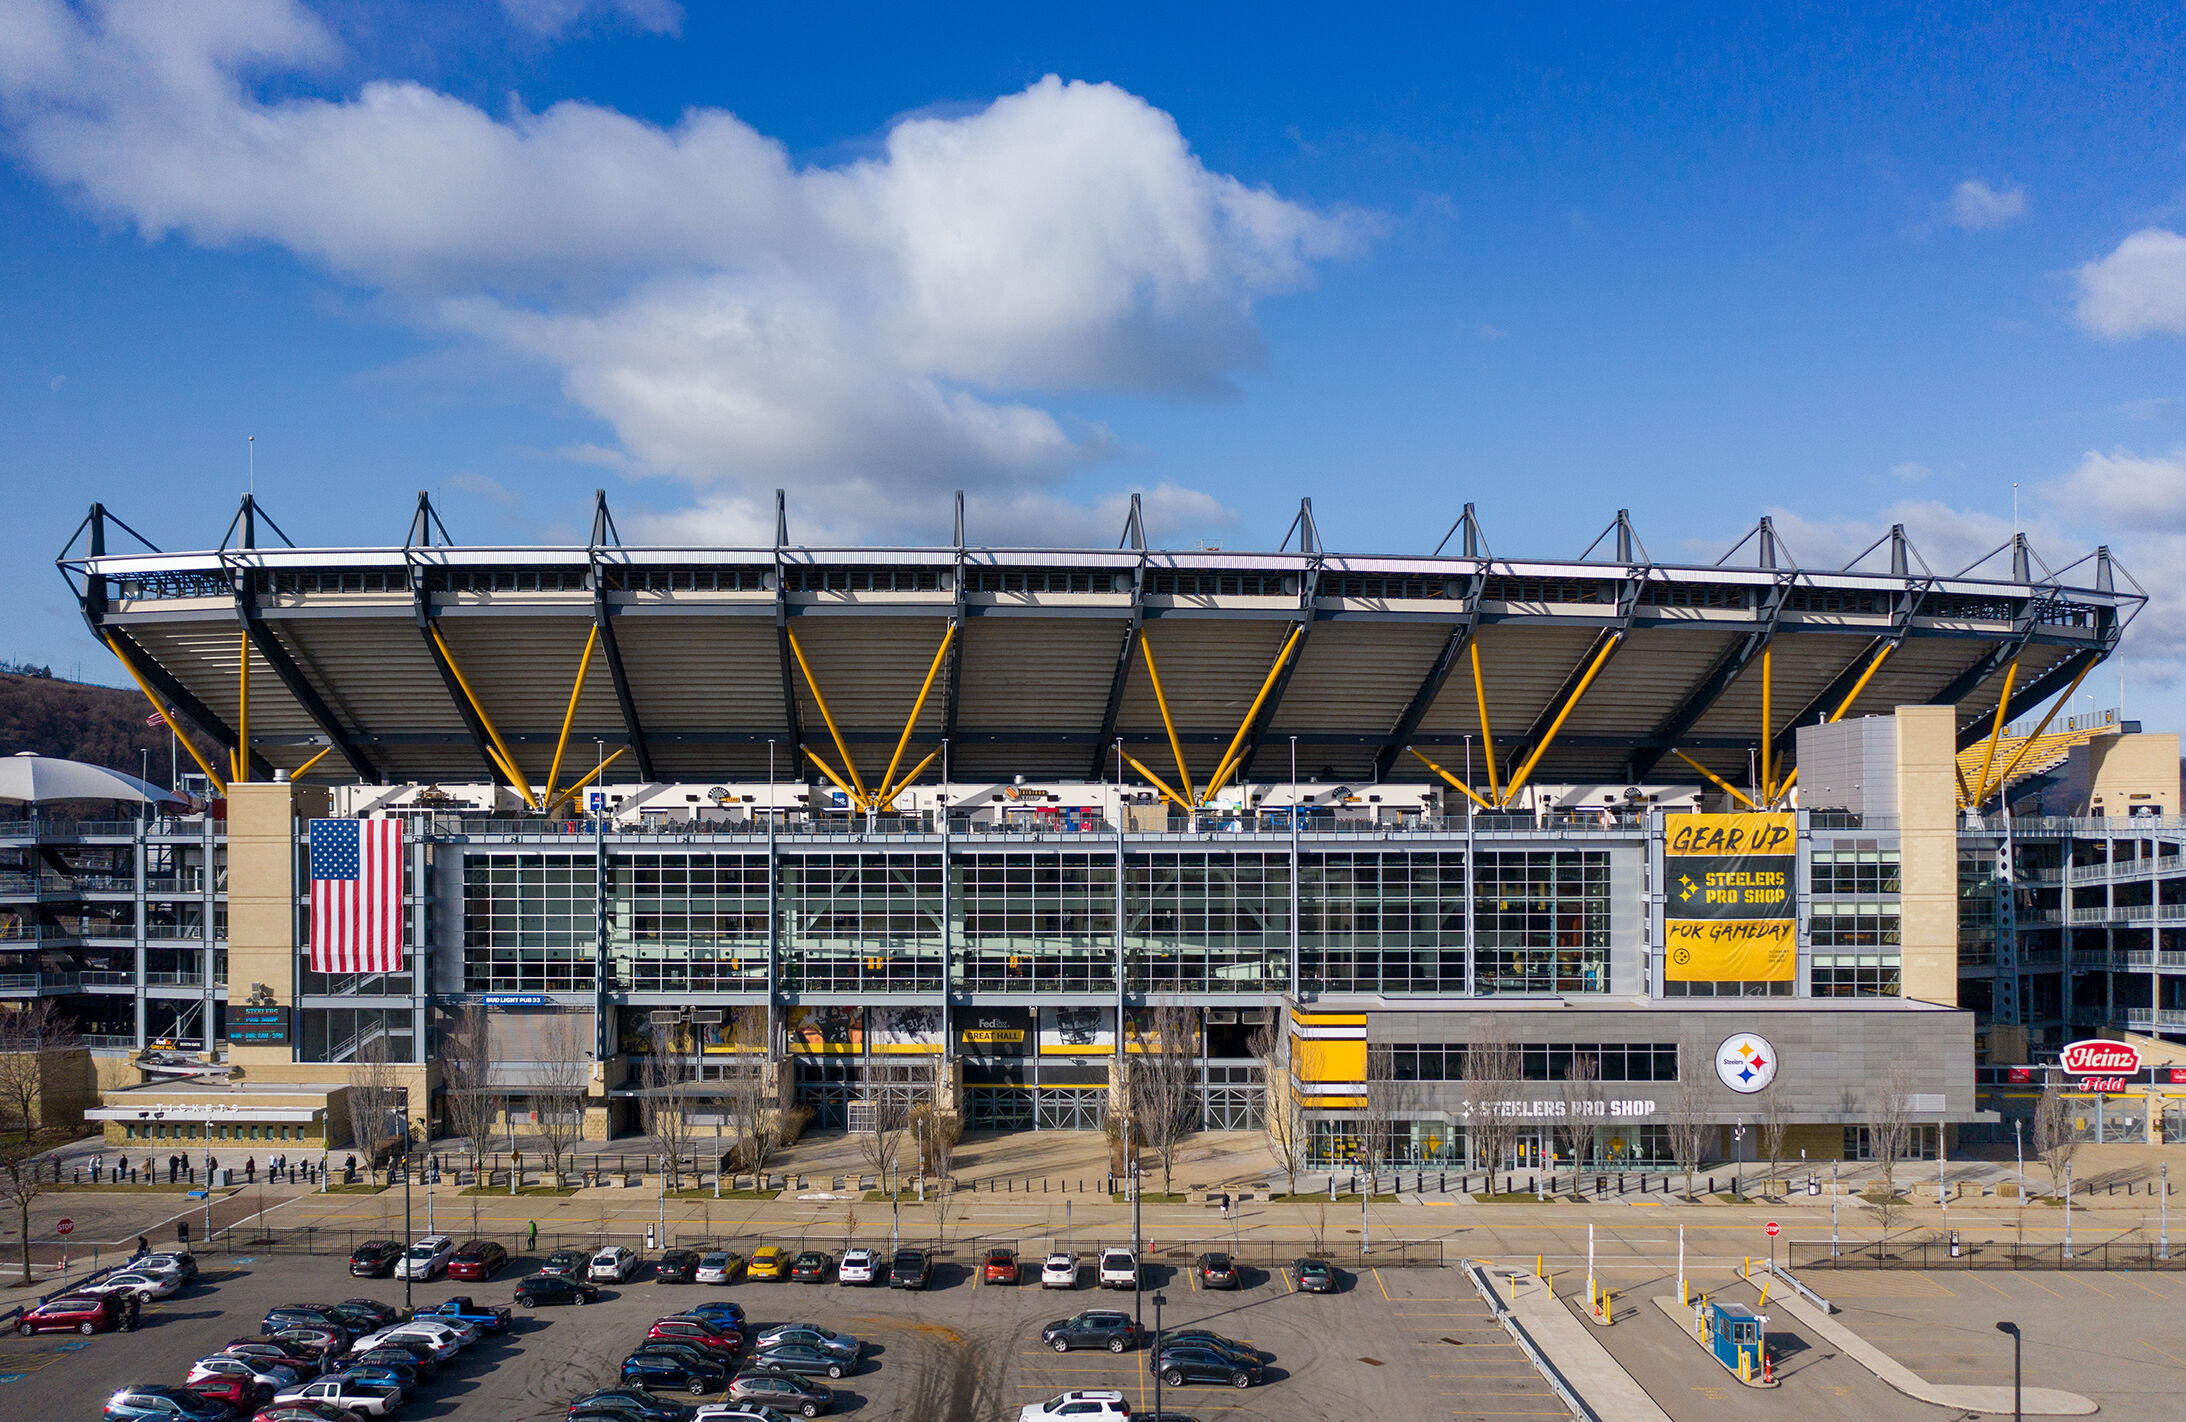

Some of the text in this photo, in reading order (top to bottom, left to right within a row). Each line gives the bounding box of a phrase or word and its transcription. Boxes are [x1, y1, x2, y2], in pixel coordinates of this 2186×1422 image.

[1672, 822, 1790, 850] GEAR UP
[1705, 871, 1785, 887] STEELERS
[1705, 889, 1786, 904] PRO SHOP
[1669, 921, 1791, 943] FOR GAMEDAY
[978, 1018, 1008, 1028] FedEx
[967, 1031, 1019, 1040] GREAT HALL
[2068, 1048, 2135, 1067] Heinz
[2079, 1077, 2126, 1091] Field
[156, 1103, 240, 1113] TICKETS
[1571, 1101, 1606, 1117] PRO
[1610, 1100, 1656, 1117] SHOP
[57, 1222, 74, 1231] STOP
